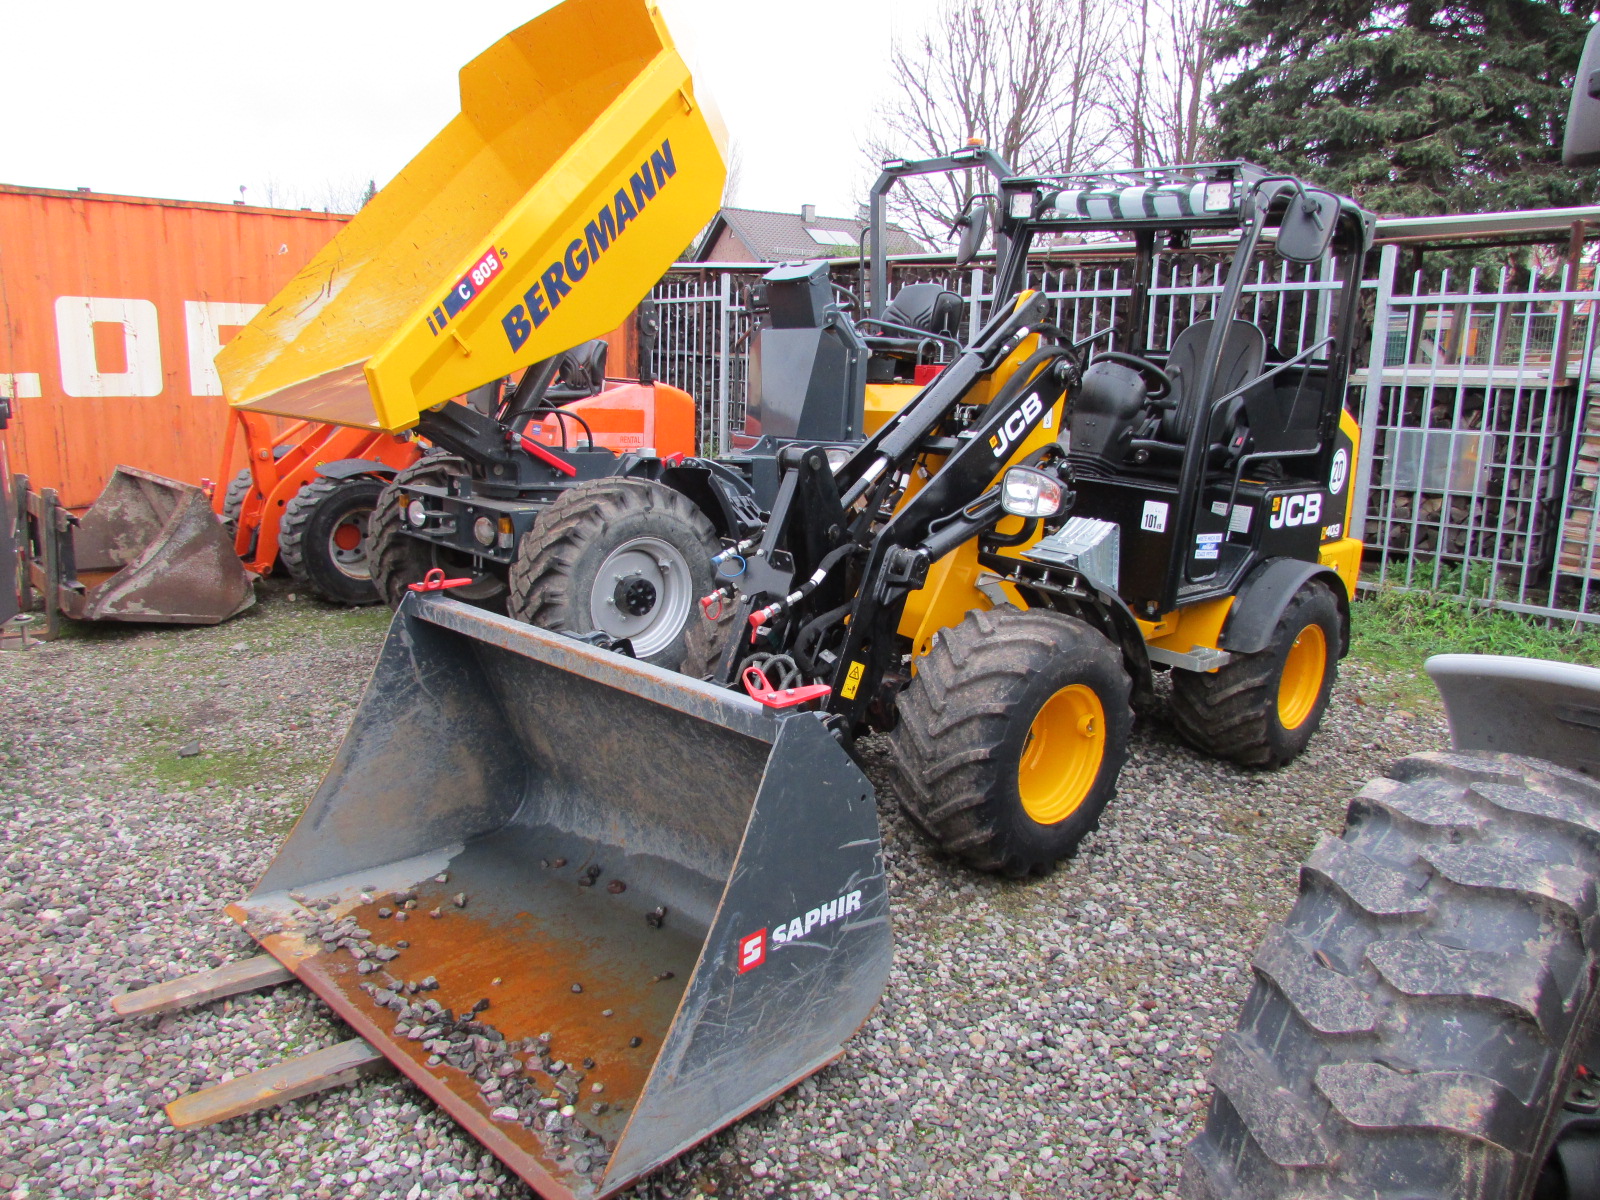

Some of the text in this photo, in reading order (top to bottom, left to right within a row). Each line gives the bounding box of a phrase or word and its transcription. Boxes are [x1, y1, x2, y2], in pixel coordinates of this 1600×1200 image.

[501, 138, 677, 353] BERGMANN
[459, 284, 471, 300] C
[472, 254, 499, 286] 805
[620, 436, 641, 444] RENTAL
[993, 392, 1042, 457] JCB
[1331, 461, 1343, 483] 20
[1145, 514, 1157, 529] 101
[1269, 493, 1322, 529] JCB
[771, 890, 862, 951] SAPHIR
